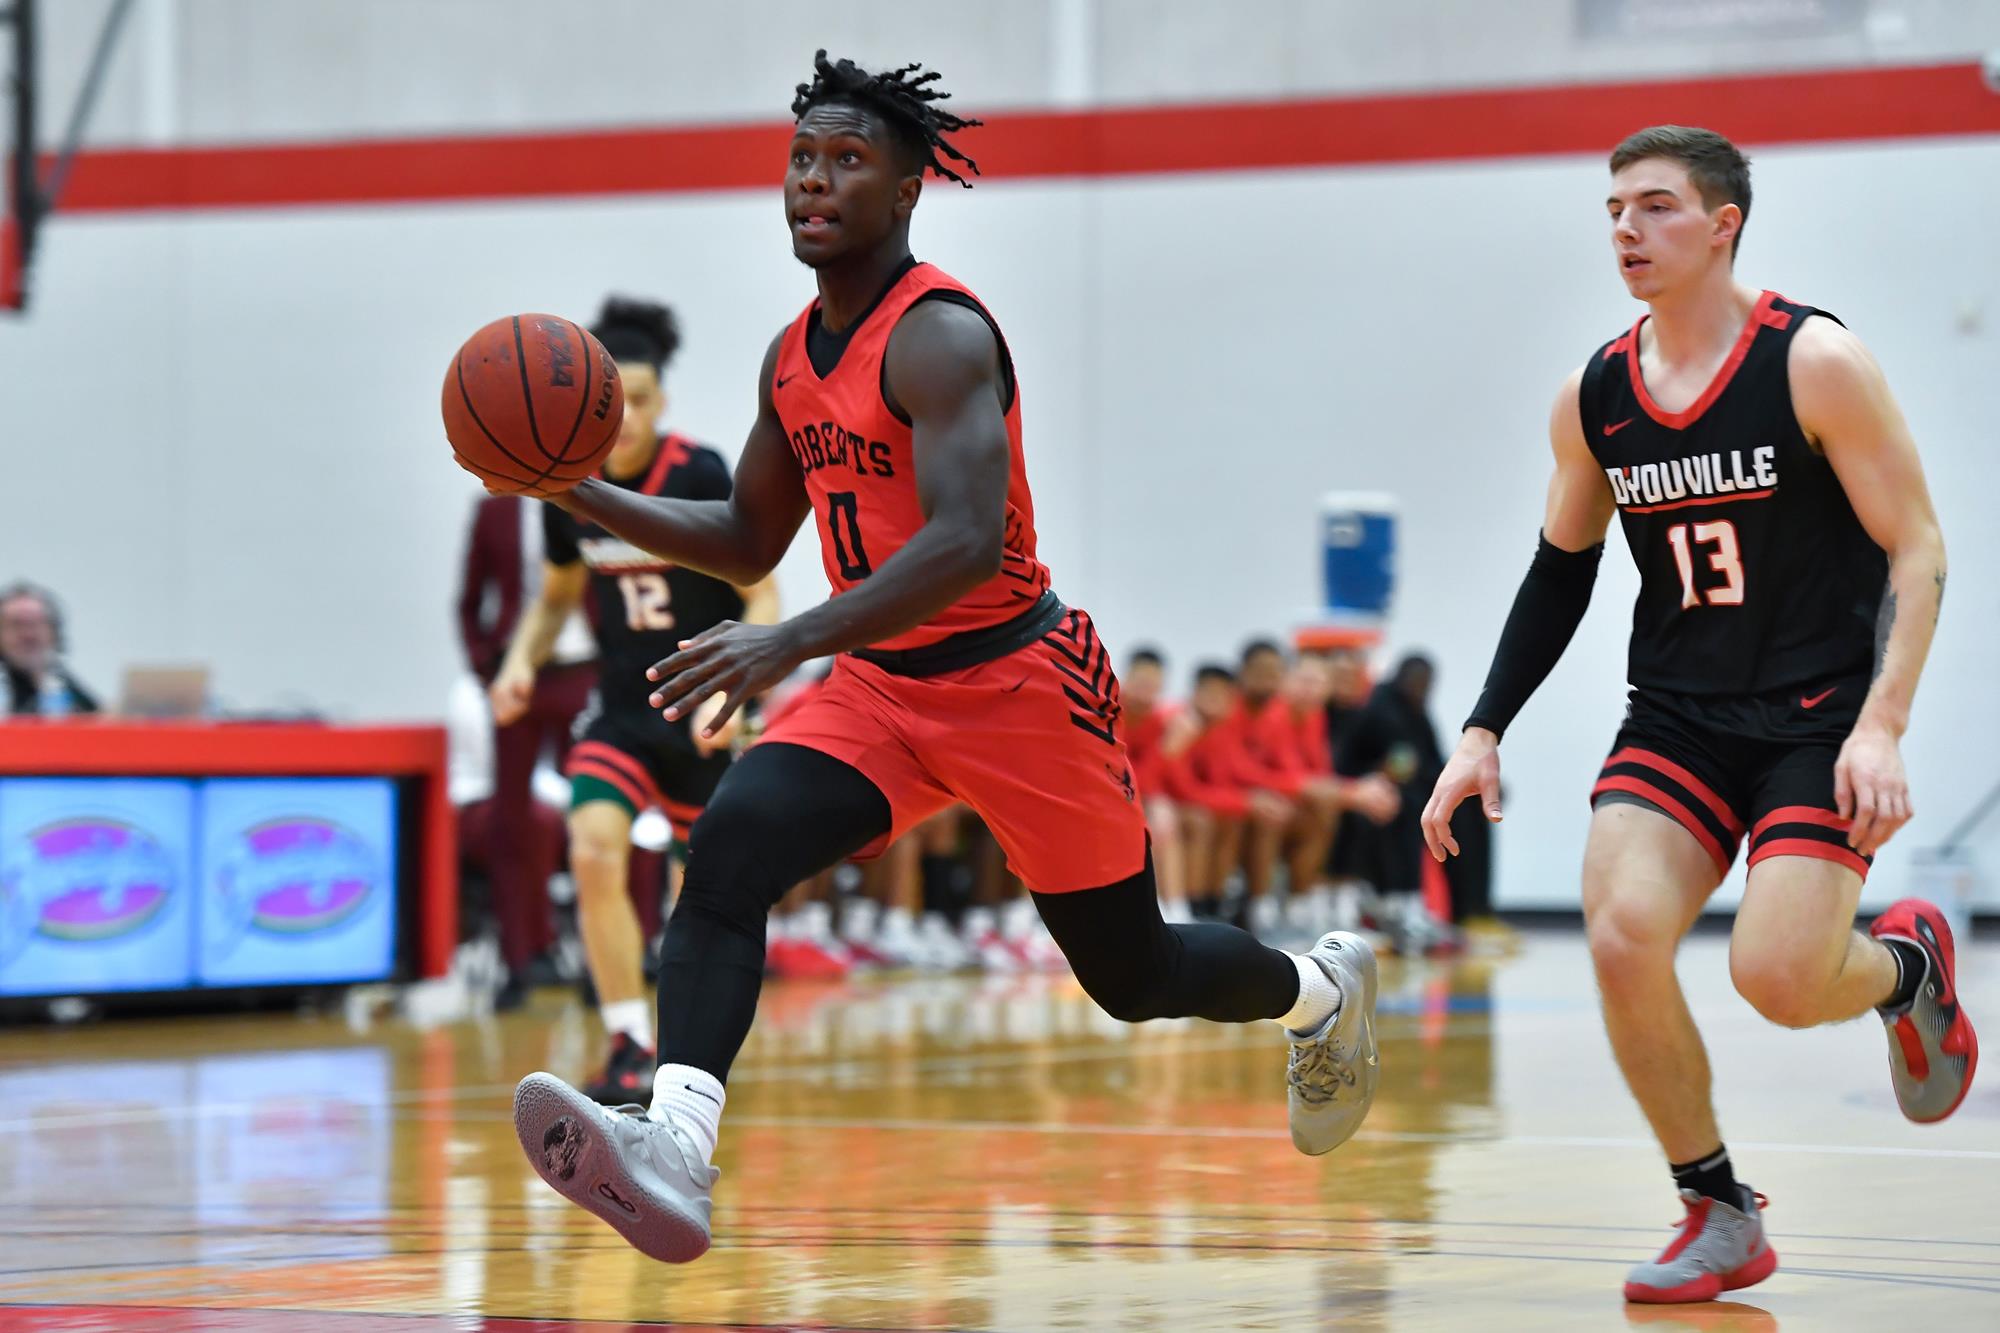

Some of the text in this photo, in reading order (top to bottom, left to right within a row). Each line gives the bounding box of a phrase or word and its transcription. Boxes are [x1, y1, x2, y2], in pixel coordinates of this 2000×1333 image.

[792, 421, 895, 478] OBERTS
[826, 491, 873, 582] 0
[1667, 518, 1746, 611] 13
[617, 572, 677, 633] 12
